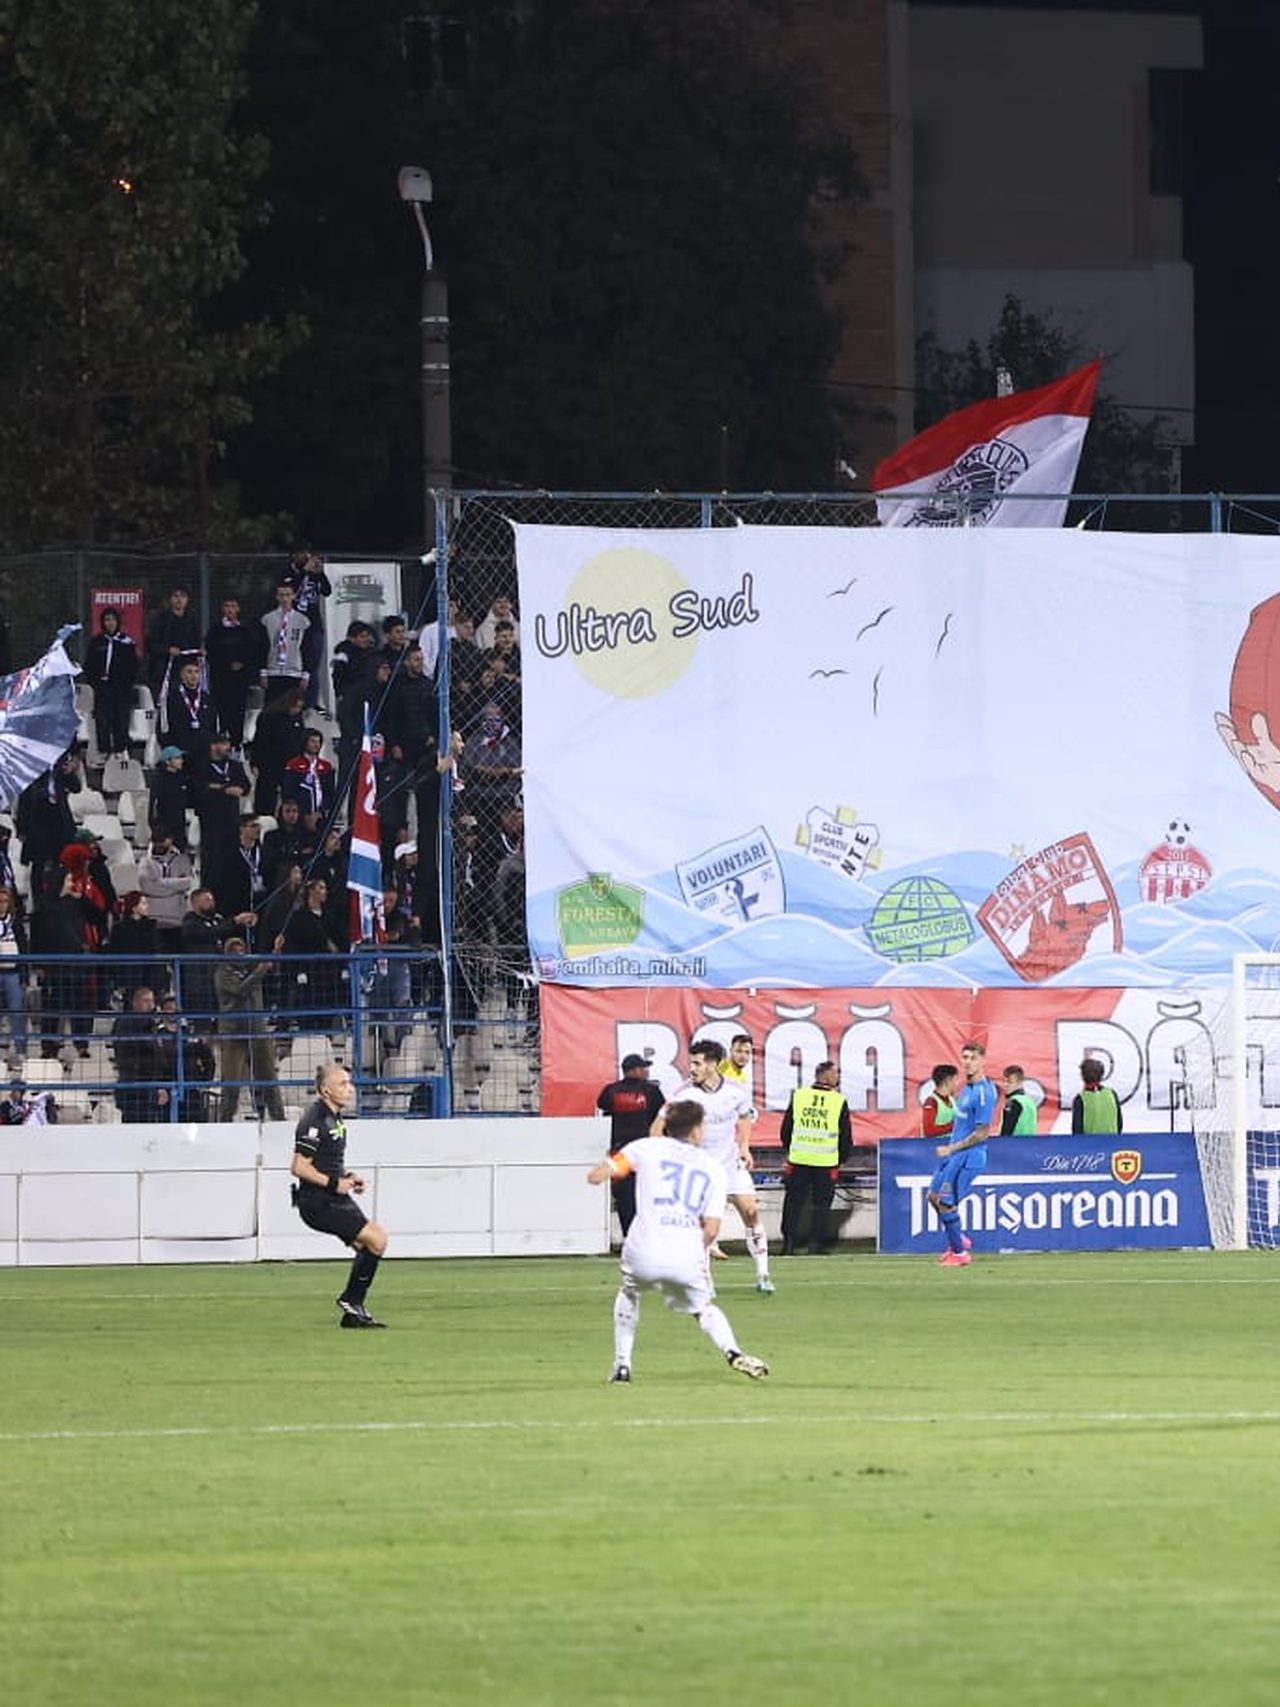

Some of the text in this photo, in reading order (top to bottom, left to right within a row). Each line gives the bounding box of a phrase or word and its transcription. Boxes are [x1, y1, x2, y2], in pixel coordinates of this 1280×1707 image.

[535, 572, 760, 658] Ultra Sud
[686, 842, 769, 889] VOLUNTARI
[990, 849, 1087, 928] DINAMO
[799, 1118, 829, 1131] MMA
[653, 1160, 711, 1214] 30
